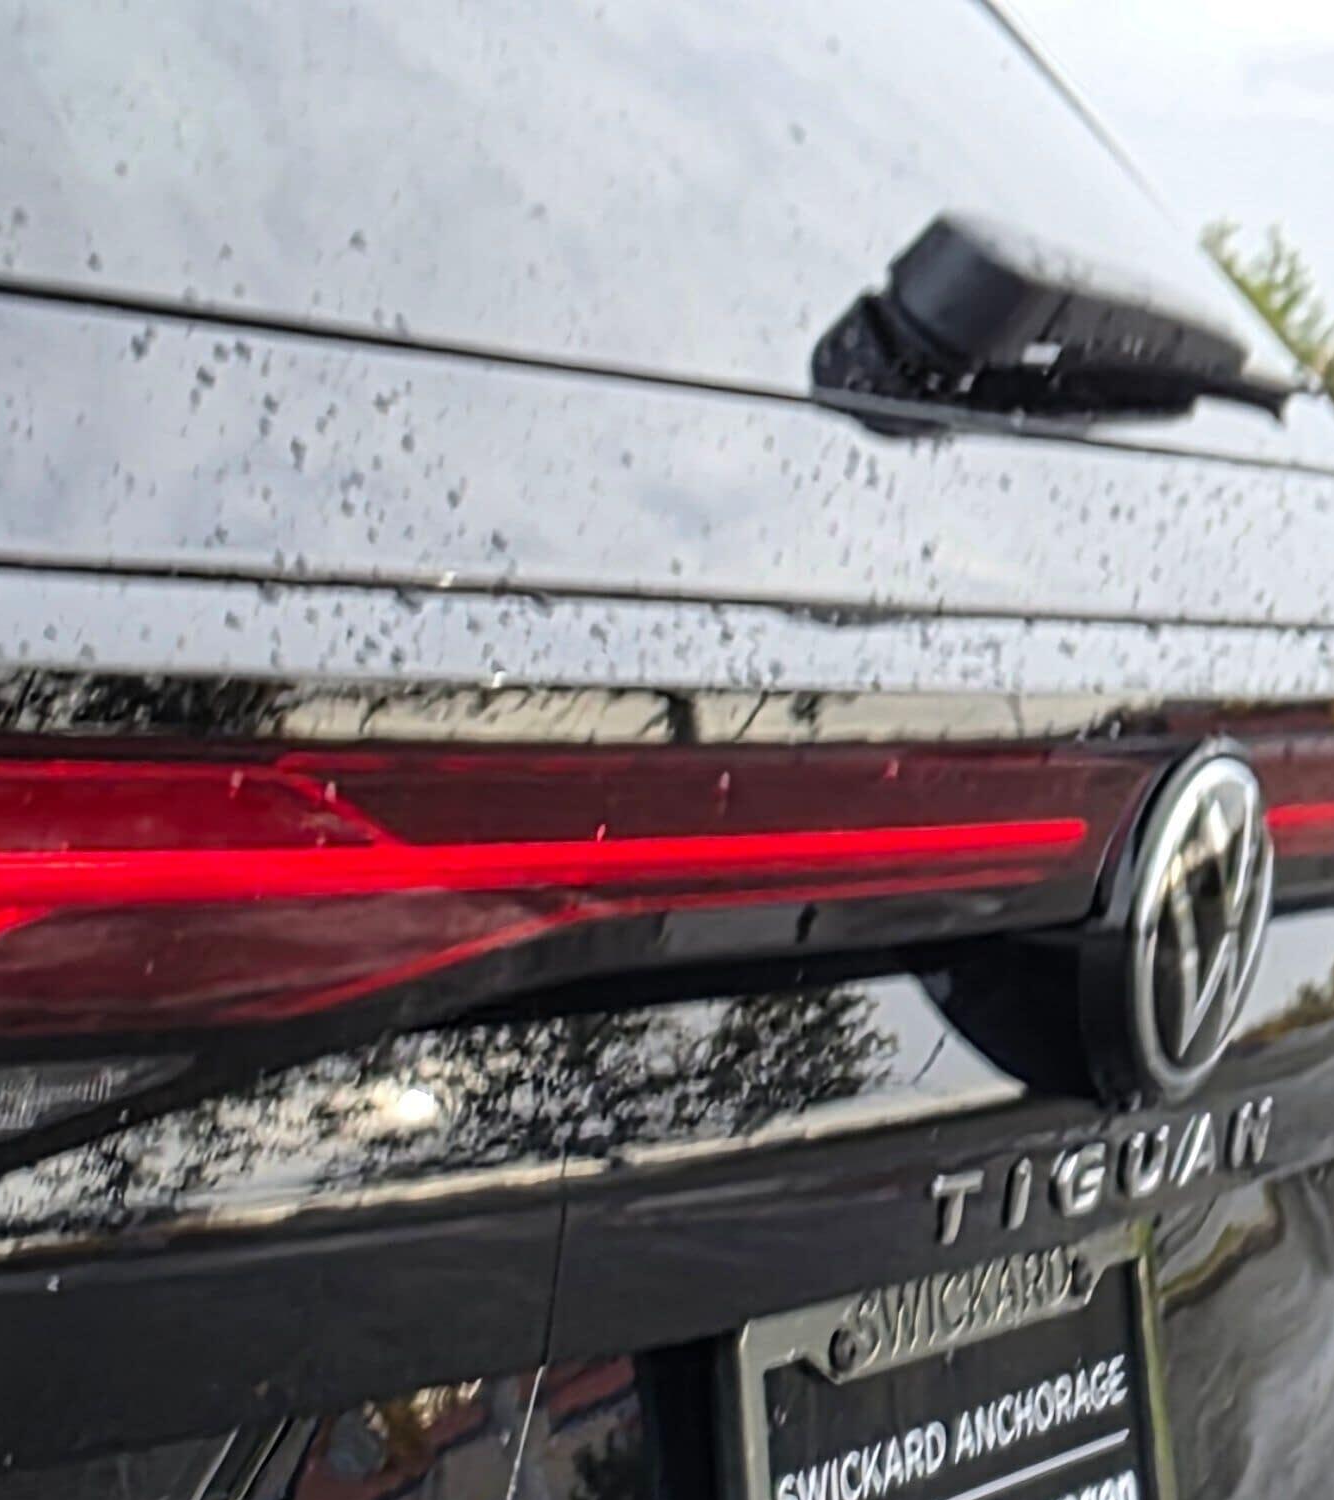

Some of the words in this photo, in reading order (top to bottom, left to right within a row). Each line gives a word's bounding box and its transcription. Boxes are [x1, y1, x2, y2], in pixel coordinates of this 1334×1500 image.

[929, 1097, 1273, 1246] TIGUAN
[853, 1246, 1073, 1365] SWICKARD
[954, 1353, 1129, 1464] ANCHORAGE
